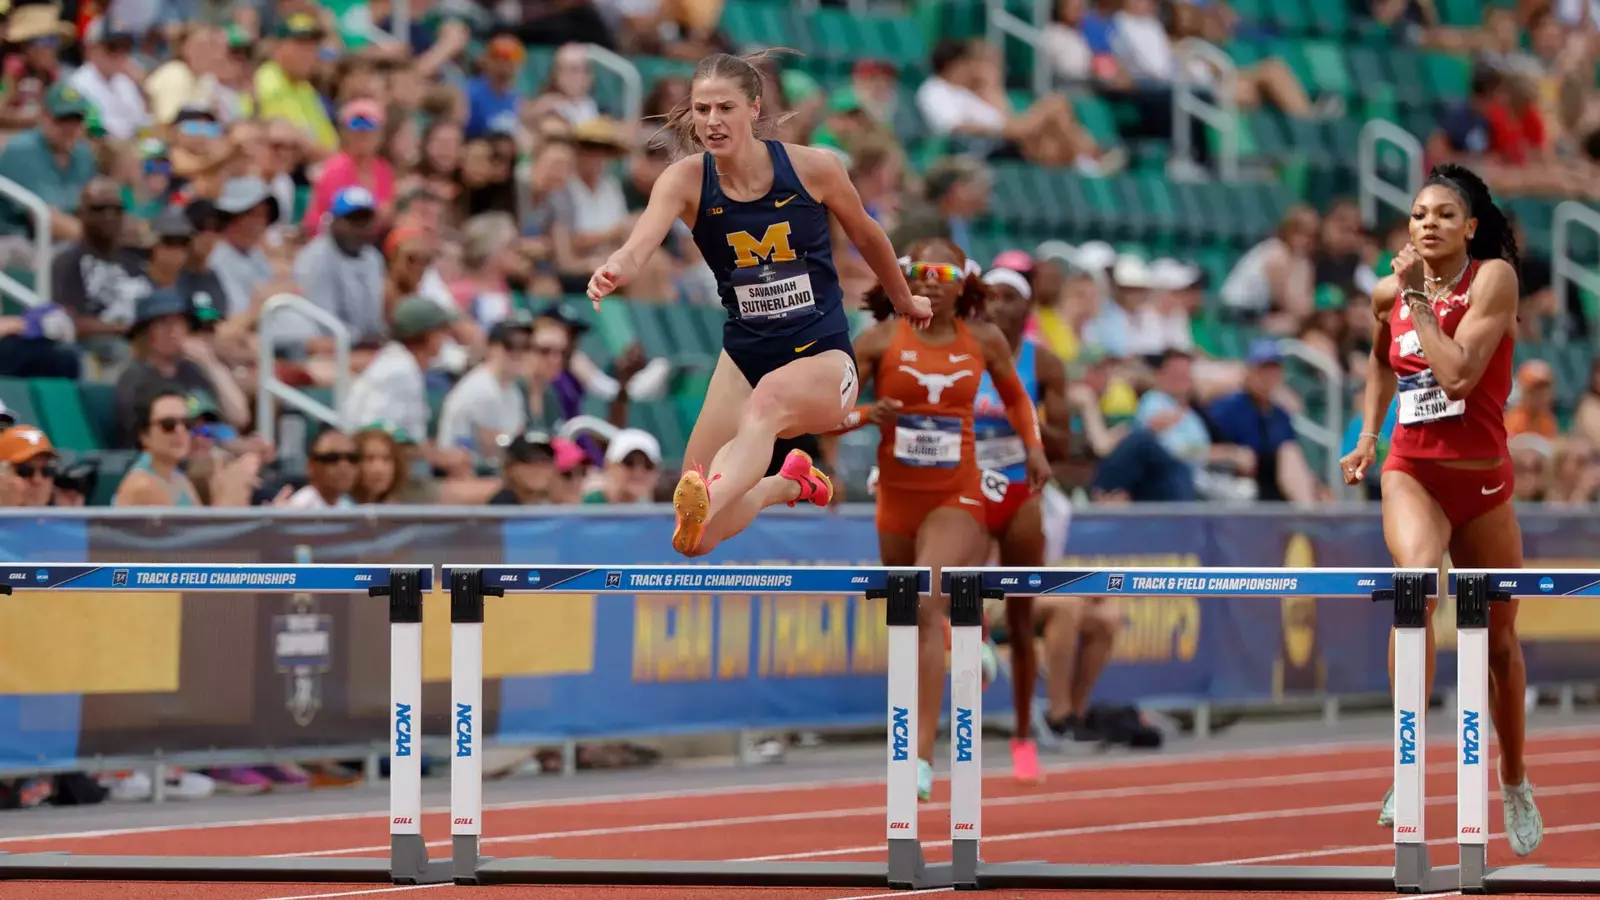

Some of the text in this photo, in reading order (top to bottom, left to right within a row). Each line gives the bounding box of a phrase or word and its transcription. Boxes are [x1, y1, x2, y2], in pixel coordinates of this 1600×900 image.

[726, 221, 797, 268] M
[748, 281, 797, 298] SAVANNAH
[741, 290, 811, 313] SUTHERLAND
[136, 572, 297, 585] TRACK & FIELD CHAMPIONSHIPS
[500, 574, 519, 582] GILL
[630, 574, 793, 587] TRACK & FIELD CHAMPIONSHIPS
[1000, 577, 1019, 585] GILL
[1132, 577, 1298, 591] TRACK & FIELD CHAMPIONSHIPS
[1357, 579, 1376, 587] GILL
[1498, 580, 1517, 588] GILL
[395, 703, 412, 757] NCAA
[456, 703, 472, 757] NCAA
[893, 707, 908, 761] NCAA
[956, 708, 972, 762] NCAA
[1399, 710, 1416, 765] NCAA
[1463, 710, 1480, 765] NCAA
